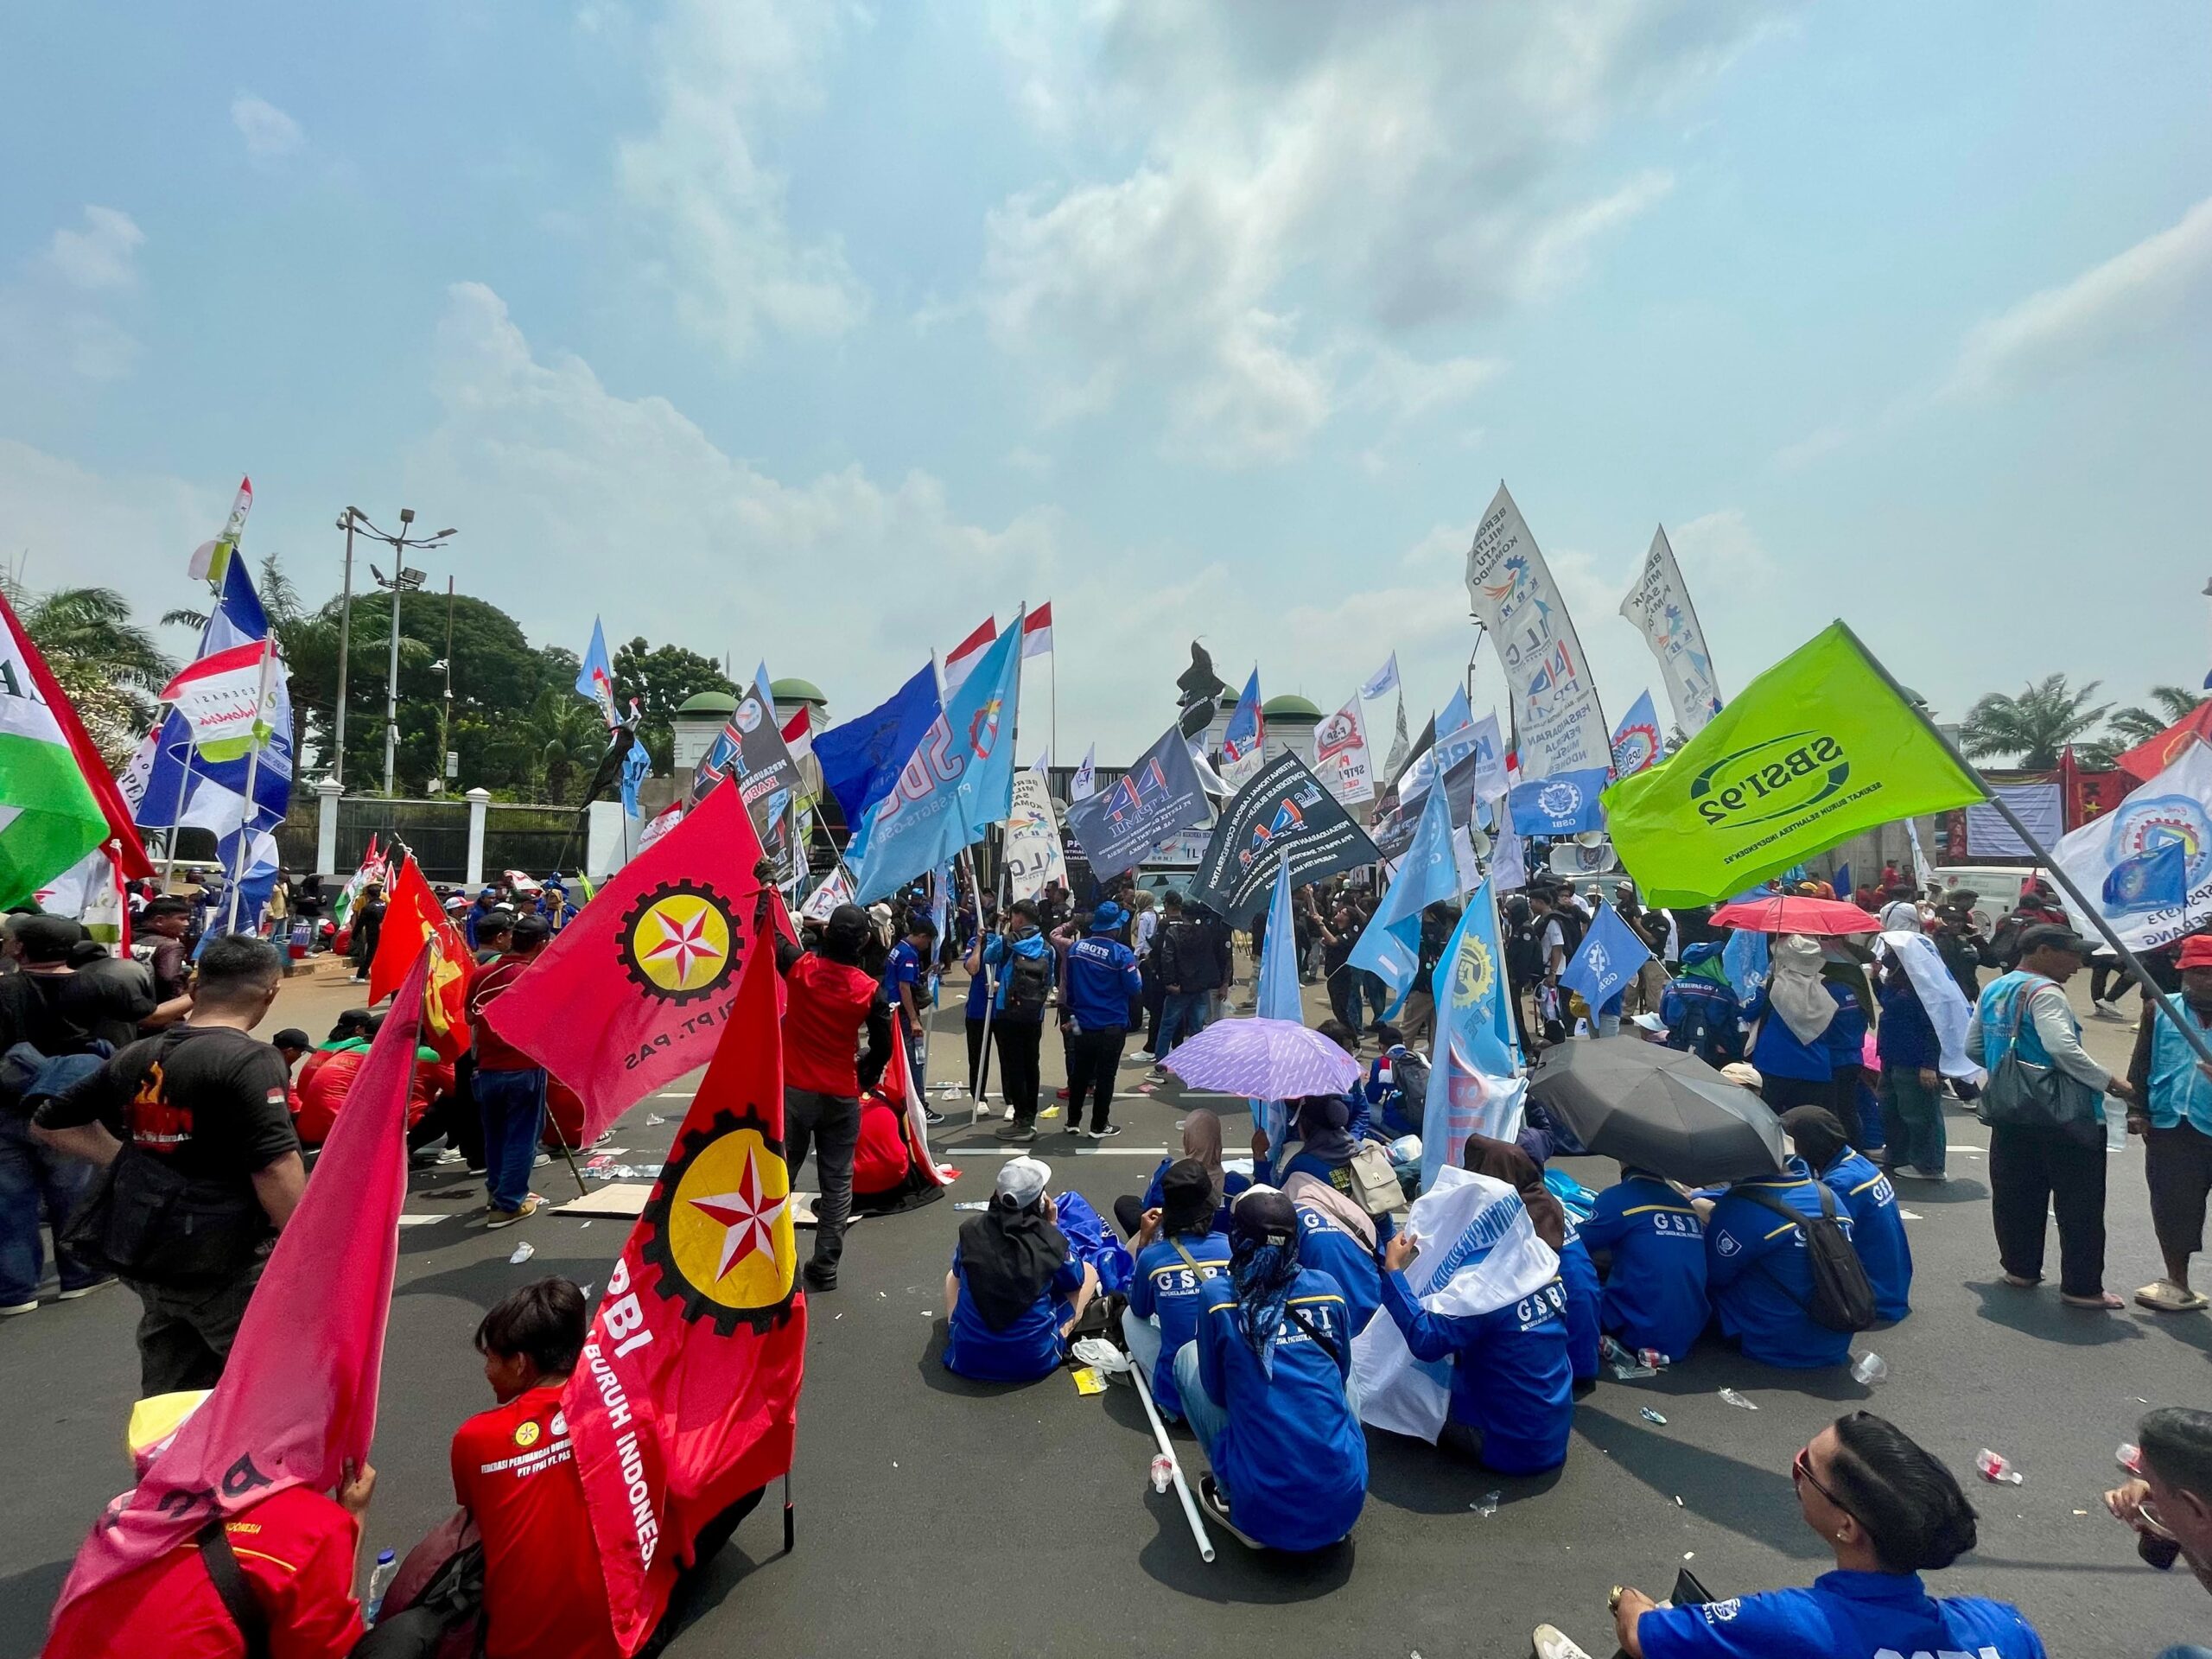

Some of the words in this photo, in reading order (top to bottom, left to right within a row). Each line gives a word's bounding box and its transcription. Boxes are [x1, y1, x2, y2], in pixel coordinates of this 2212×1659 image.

[1077, 942, 1109, 957] SBGTS
[1516, 1282, 1567, 1322] GSBI
[583, 1344, 632, 1429] BURUH
[508, 1446, 550, 1468] PERJUANGAN
[517, 1465, 531, 1478] PTP
[548, 1454, 558, 1466] PT.
[558, 1450, 571, 1463] PAS
